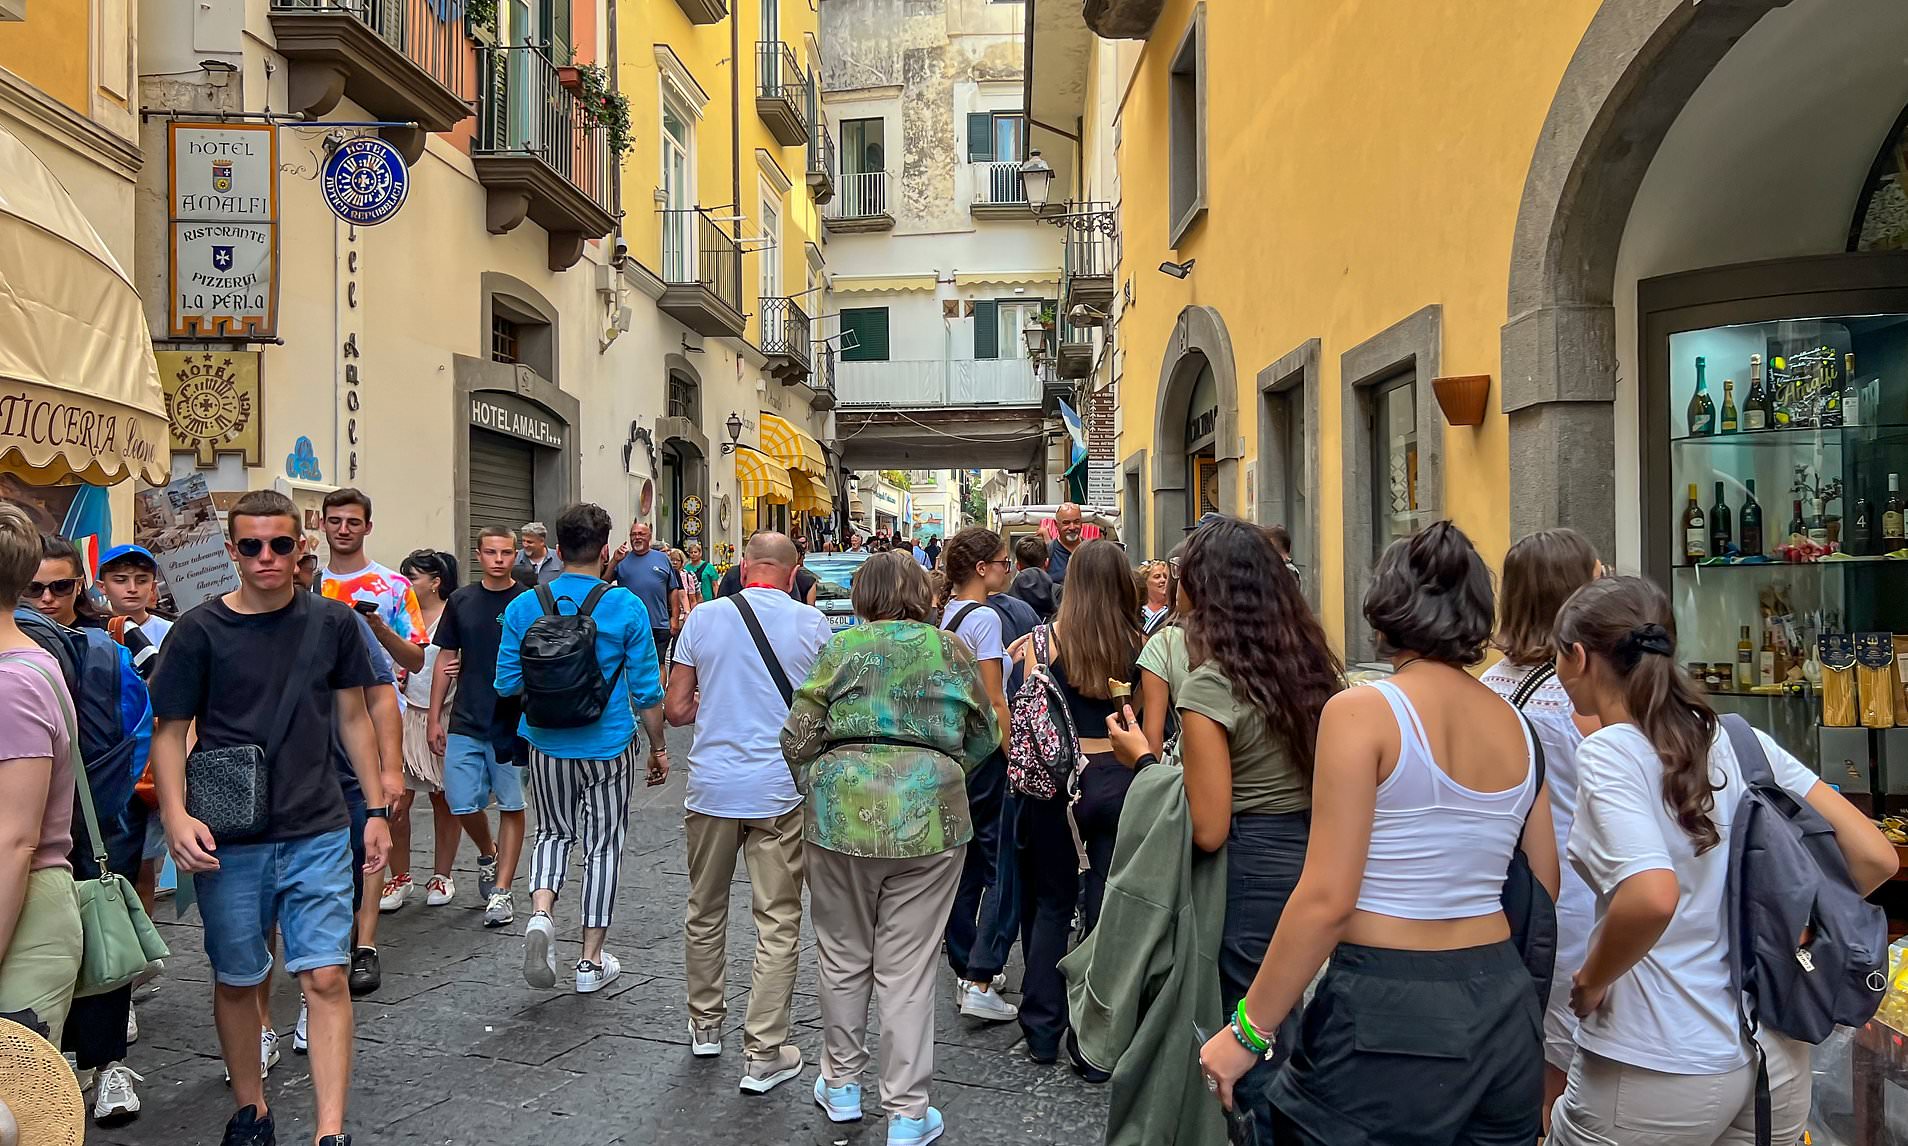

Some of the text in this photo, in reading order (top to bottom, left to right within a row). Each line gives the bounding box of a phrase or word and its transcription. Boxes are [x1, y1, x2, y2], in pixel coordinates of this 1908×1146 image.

[189, 141, 254, 156] HOTEL
[345, 142, 387, 158] HOTEL
[182, 193, 267, 214] AMALFI
[326, 176, 403, 220] ANTICA REPUBBLICA
[183, 226, 266, 244] RISTORANTE
[191, 271, 257, 289] PIZZERIA
[176, 364, 236, 385] HOTEL
[1775, 364, 1838, 406] Amalfi
[0, 393, 117, 457] TICCERIA
[473, 400, 549, 442] HOTEL AMALFI
[1856, 514, 1867, 528] 4
[826, 616, 849, 625] 64DL
